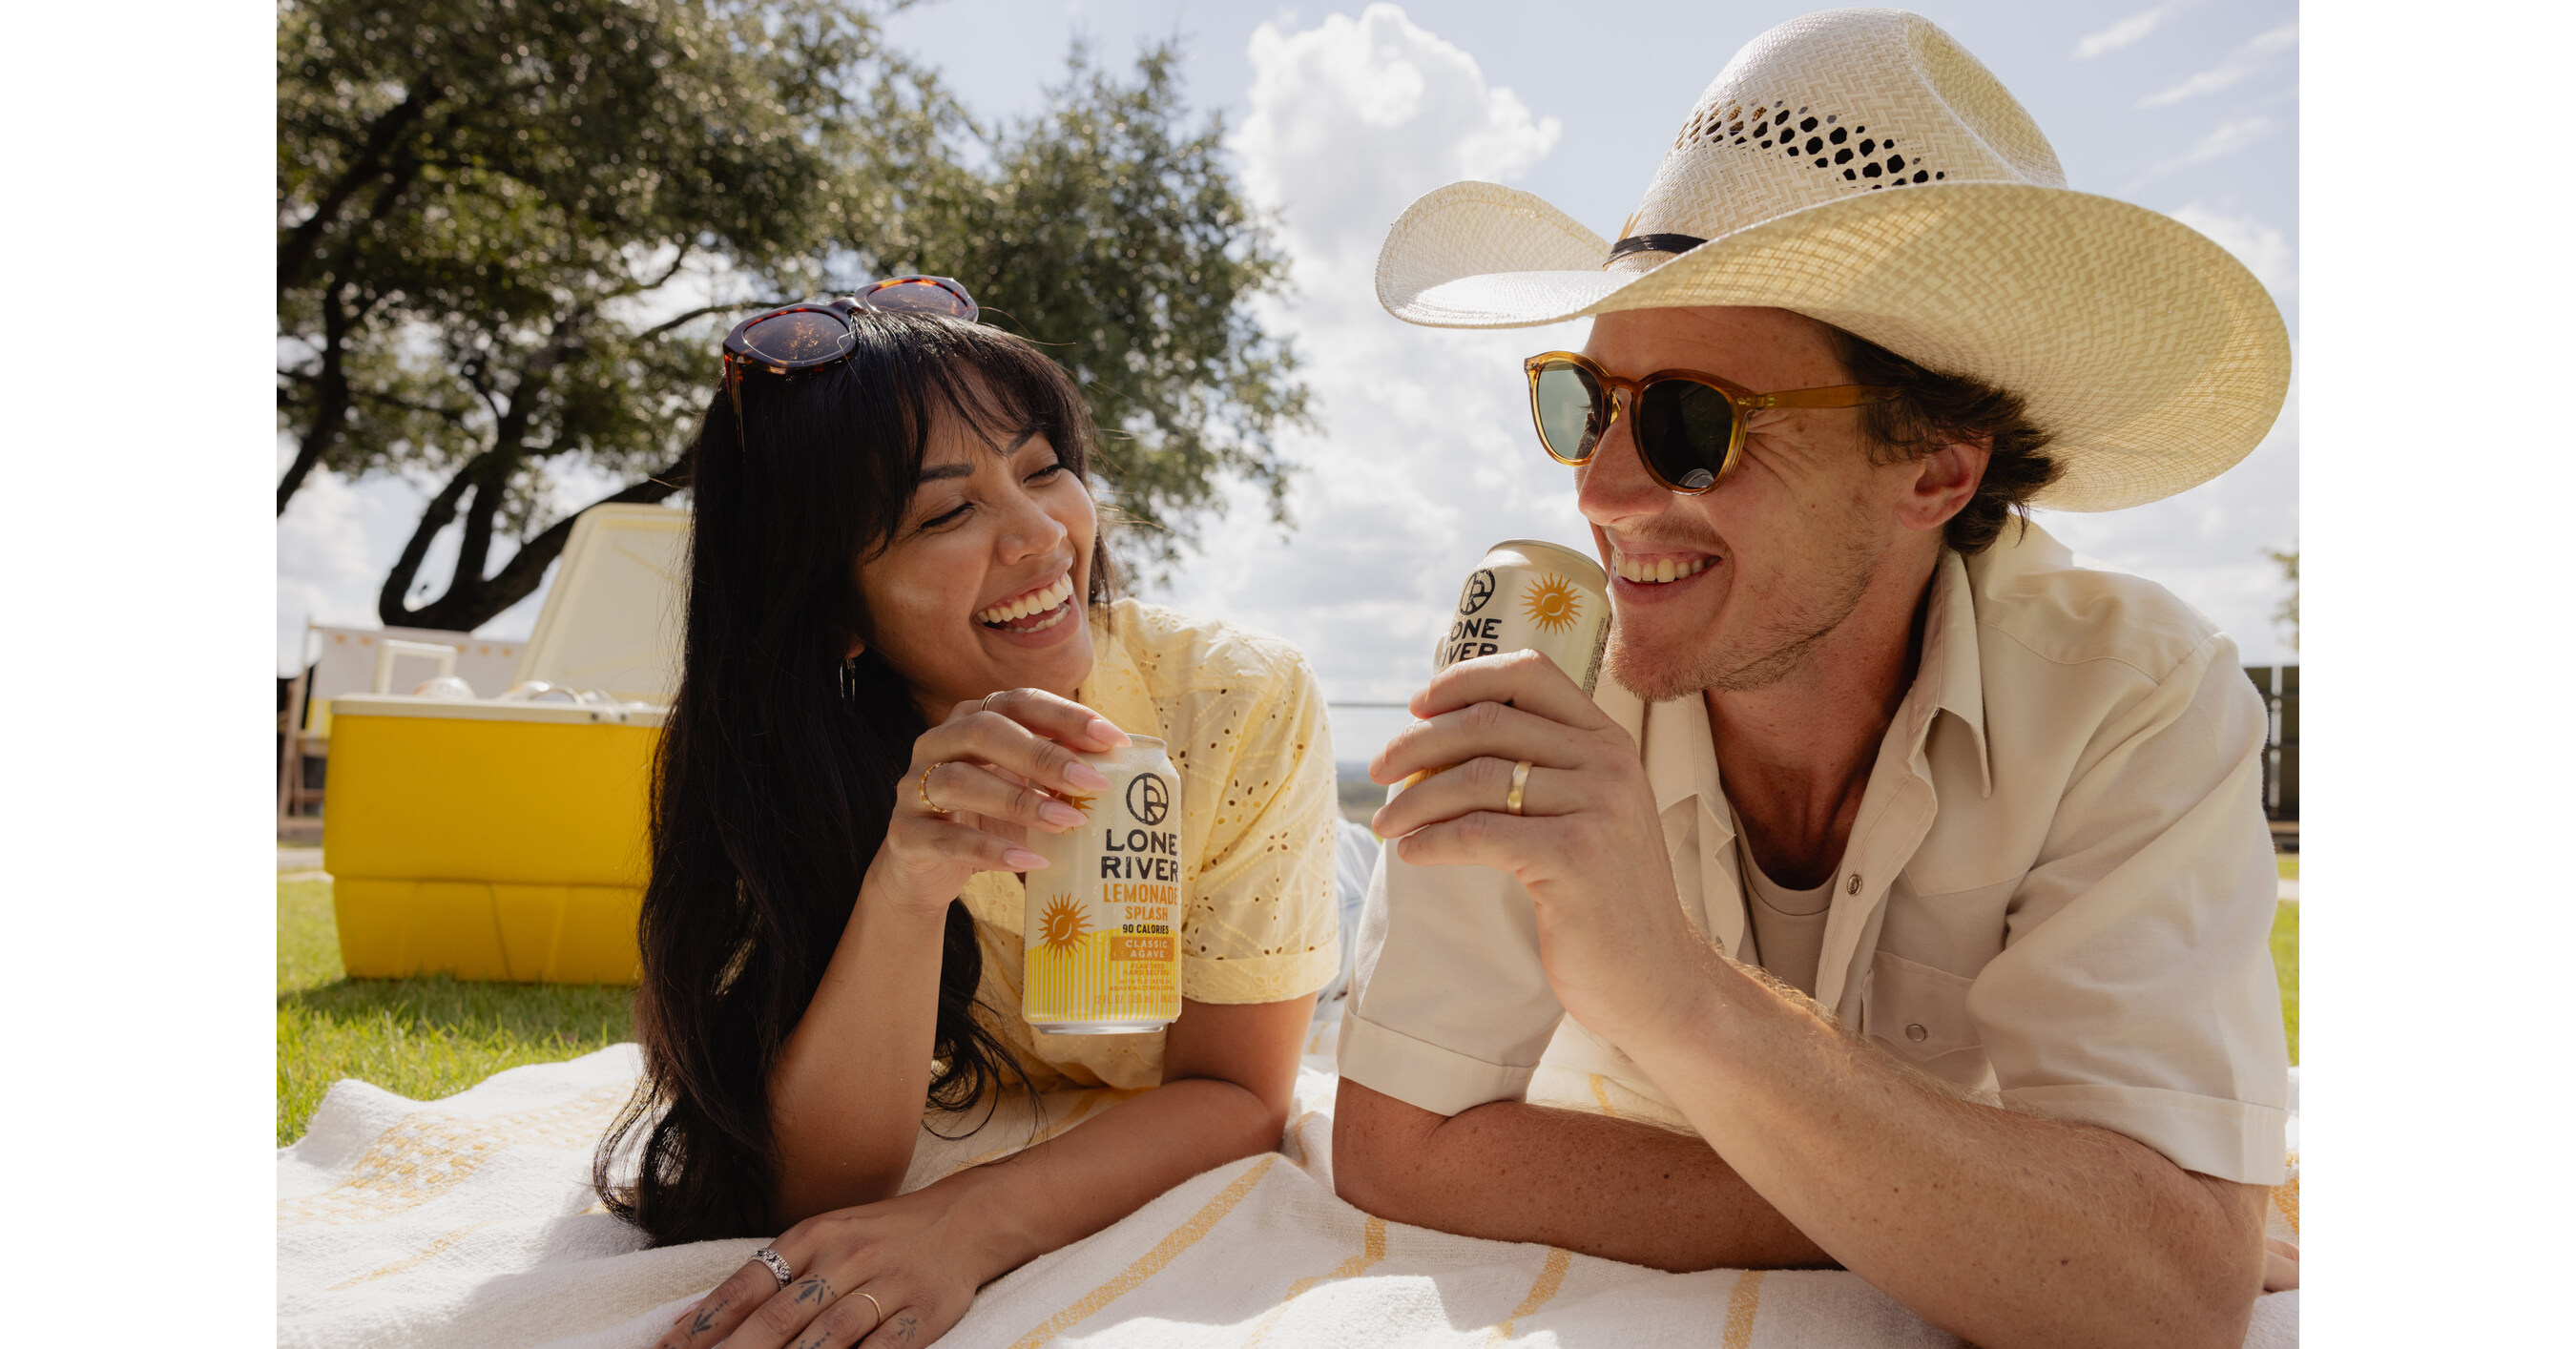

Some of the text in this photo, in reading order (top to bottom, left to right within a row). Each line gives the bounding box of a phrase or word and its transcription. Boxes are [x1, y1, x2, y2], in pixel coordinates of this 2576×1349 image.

[1449, 617, 1503, 642] ONE
[1442, 642, 1499, 667] IVER
[1106, 828, 1177, 856] LONE
[1101, 856, 1178, 882] RIVER
[1103, 883, 1177, 905] LEMONADE
[1125, 905, 1169, 922] SPLASH
[1122, 924, 1170, 935] 90 CALORIES
[1125, 940, 1168, 948] CLASSIC
[1130, 949, 1165, 958] AGAVE
